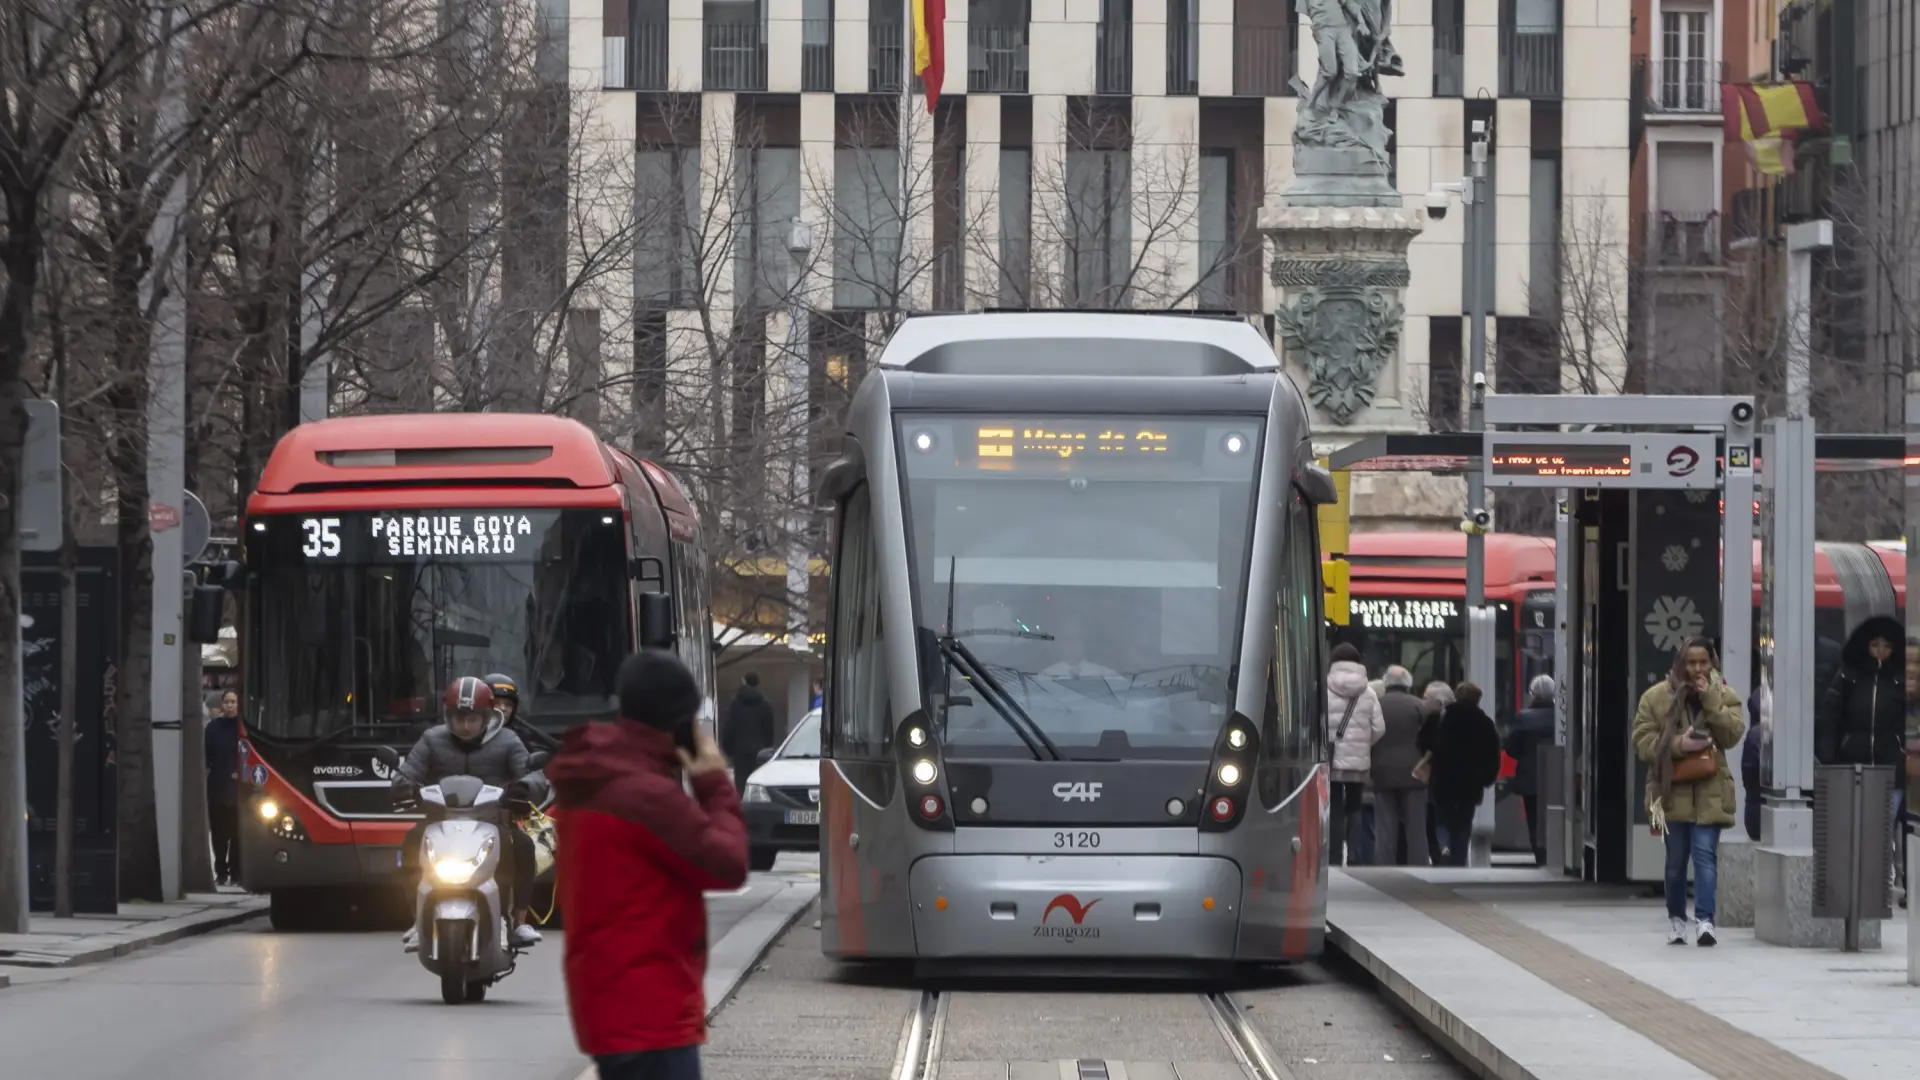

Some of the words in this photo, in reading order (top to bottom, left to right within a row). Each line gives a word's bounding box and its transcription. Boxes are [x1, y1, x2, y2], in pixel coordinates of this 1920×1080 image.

[1024, 429, 1086, 457] Mago
[1099, 430, 1125, 450] de
[372, 516, 461, 537] PARQUE
[474, 515, 531, 535] GOYA
[302, 518, 341, 557] 35
[388, 534, 515, 555] SEMINARIO
[1350, 599, 1399, 614] SANTA
[1405, 600, 1458, 616] ISABEL
[313, 766, 353, 775] avanza
[1052, 782, 1103, 802] CAF
[1054, 832, 1100, 848] 3120
[1033, 926, 1100, 944] zaragoza
